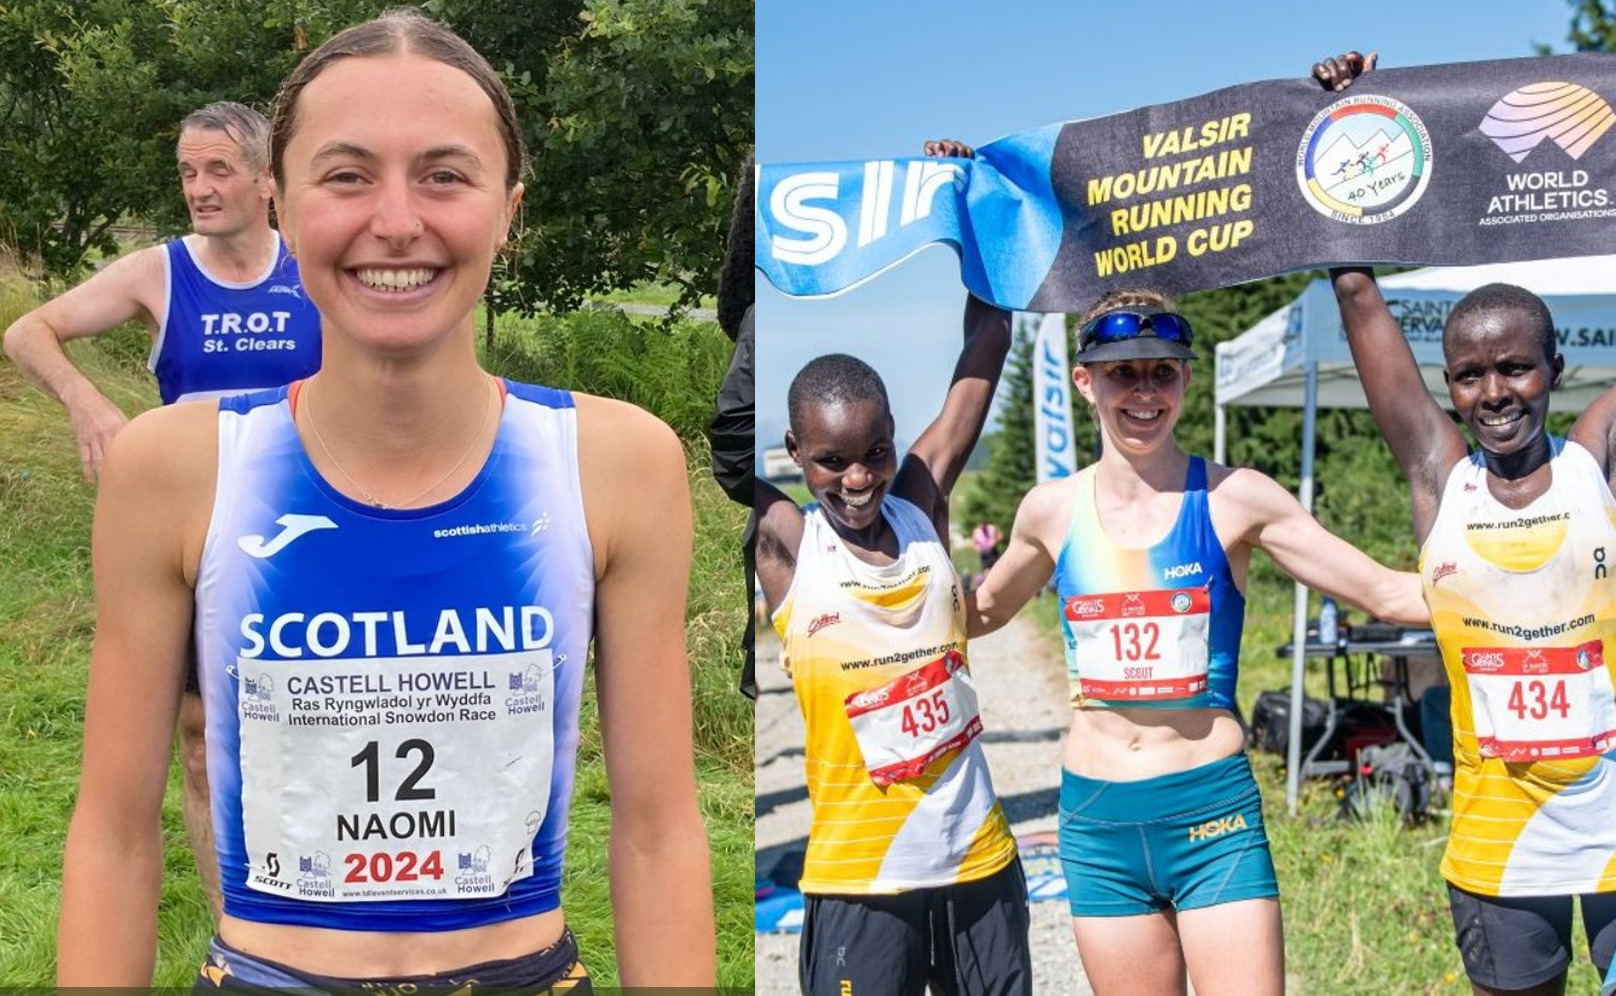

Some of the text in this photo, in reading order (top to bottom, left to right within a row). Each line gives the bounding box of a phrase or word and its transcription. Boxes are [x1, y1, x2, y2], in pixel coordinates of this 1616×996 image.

[1142, 112, 1252, 159] VALSIR
[1308, 99, 1350, 133] MOUNTAIN
[1353, 96, 1398, 107] RUNNING
[1398, 104, 1433, 162] ASSOCIATION
[1087, 147, 1253, 206] MOUNTAIN
[1348, 171, 1405, 201] 40 Years
[1506, 170, 1589, 192] WORLD
[1110, 184, 1252, 237] RUNNING
[1487, 189, 1608, 214] ATHLETICS
[1330, 210, 1365, 224] SINCE
[1479, 213, 1537, 226] ASSOCIATED
[1094, 220, 1254, 278] WORLD CUP
[201, 311, 291, 335] T.R.O.T
[1396, 315, 1444, 333] ERVA
[203, 338, 296, 353] St. Clears
[433, 522, 527, 538] scottishathletics
[1164, 562, 1203, 580] HOKA
[239, 606, 555, 658] SCOTLAND
[1462, 613, 1595, 640] www.run2gether.com
[1110, 622, 1161, 661] 132
[287, 671, 496, 696] CASTELL HOWELL
[1124, 667, 1154, 679] SCOUT
[241, 701, 276, 713] Castell
[292, 692, 491, 713] Ras Ryngwladol yr Wyddfa
[505, 693, 542, 707] Castell
[508, 701, 545, 715] Howell
[1507, 679, 1570, 720] 434
[244, 711, 280, 722] Howell
[288, 708, 496, 726] International Snowdon Race
[901, 689, 950, 738] 435
[350, 738, 436, 802] 12
[336, 810, 456, 841] NAOMI
[1189, 812, 1247, 843] HOKA
[344, 850, 445, 884] 2024
[253, 874, 293, 890] SCOTT
[296, 877, 333, 889] Castell
[454, 875, 492, 886] Castell
[457, 883, 495, 894] Howell
[299, 888, 335, 898] Howell
